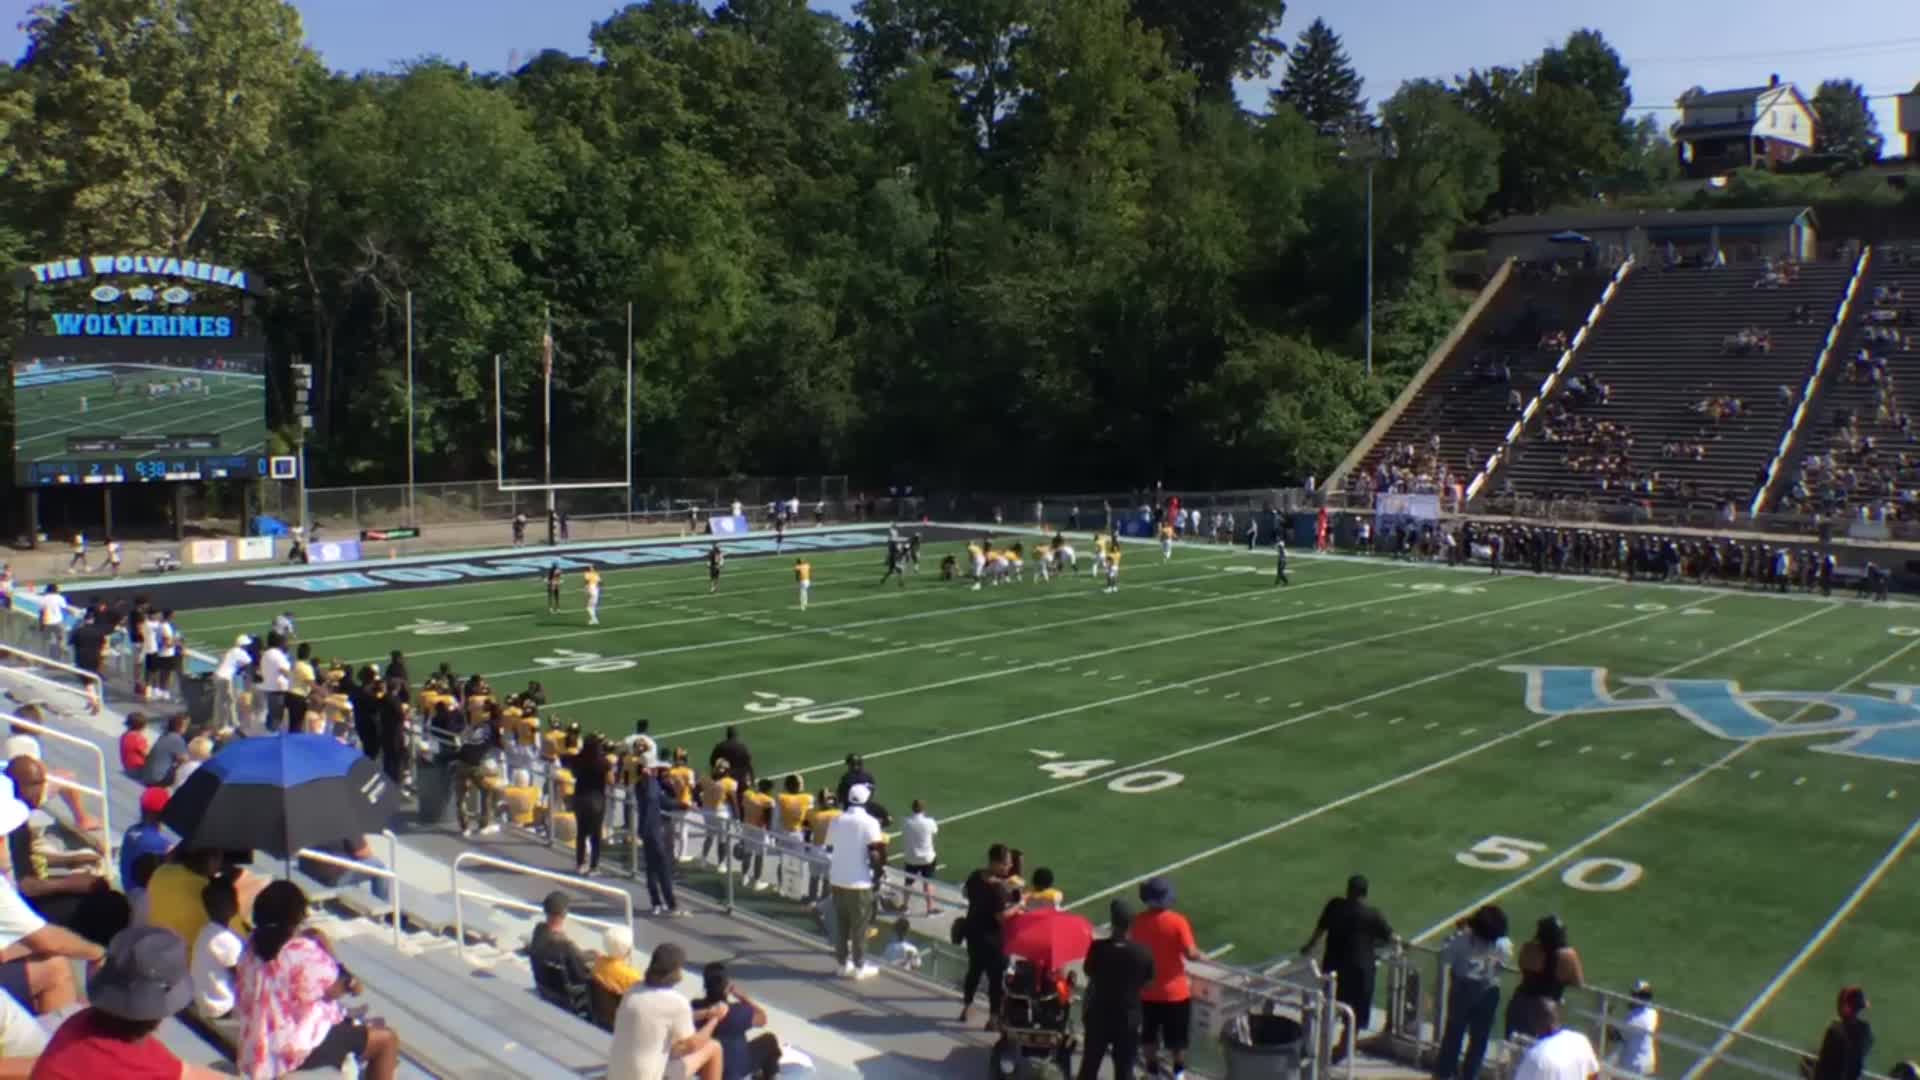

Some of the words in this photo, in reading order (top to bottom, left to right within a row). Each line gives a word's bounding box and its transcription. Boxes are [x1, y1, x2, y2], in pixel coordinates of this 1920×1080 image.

[31, 258, 83, 282] THE
[90, 256, 247, 289] WOLVARENA
[52, 313, 232, 337] WOLVERINES
[743, 694, 863, 723] 30
[1037, 758, 1186, 793] 40
[1456, 835, 1644, 892] 50
